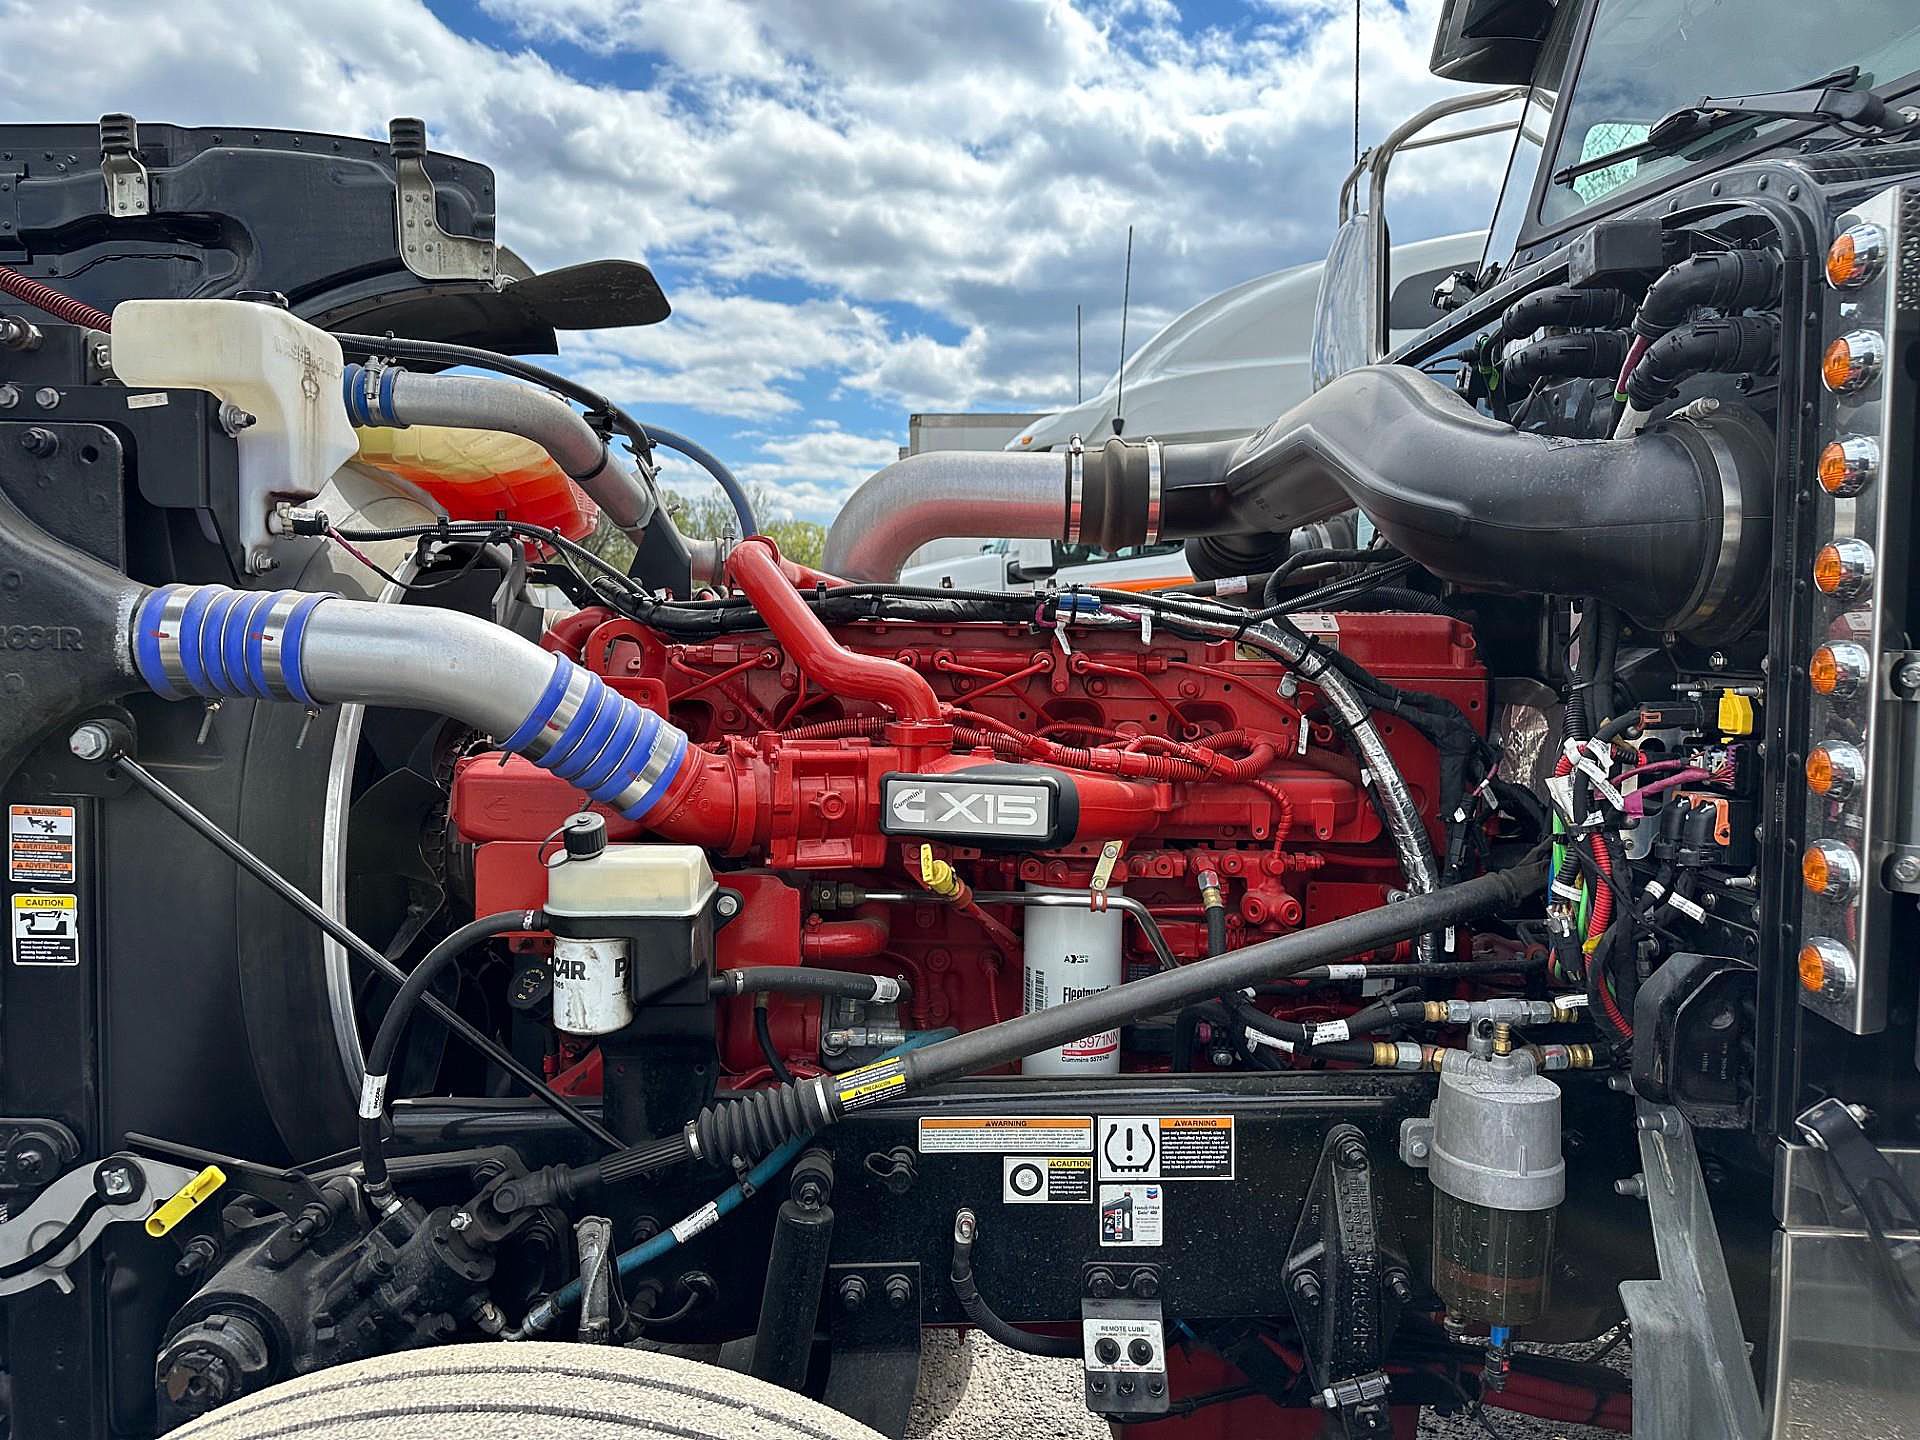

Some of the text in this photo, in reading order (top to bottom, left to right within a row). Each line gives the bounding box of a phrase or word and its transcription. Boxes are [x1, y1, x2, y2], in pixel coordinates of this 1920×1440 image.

[31, 808, 62, 816] WARNING
[936, 792, 1038, 826] X15
[25, 898, 64, 907] CAUTION
[1063, 985, 1110, 1004] Fleet
[1063, 1031, 1118, 1048] F5971NN
